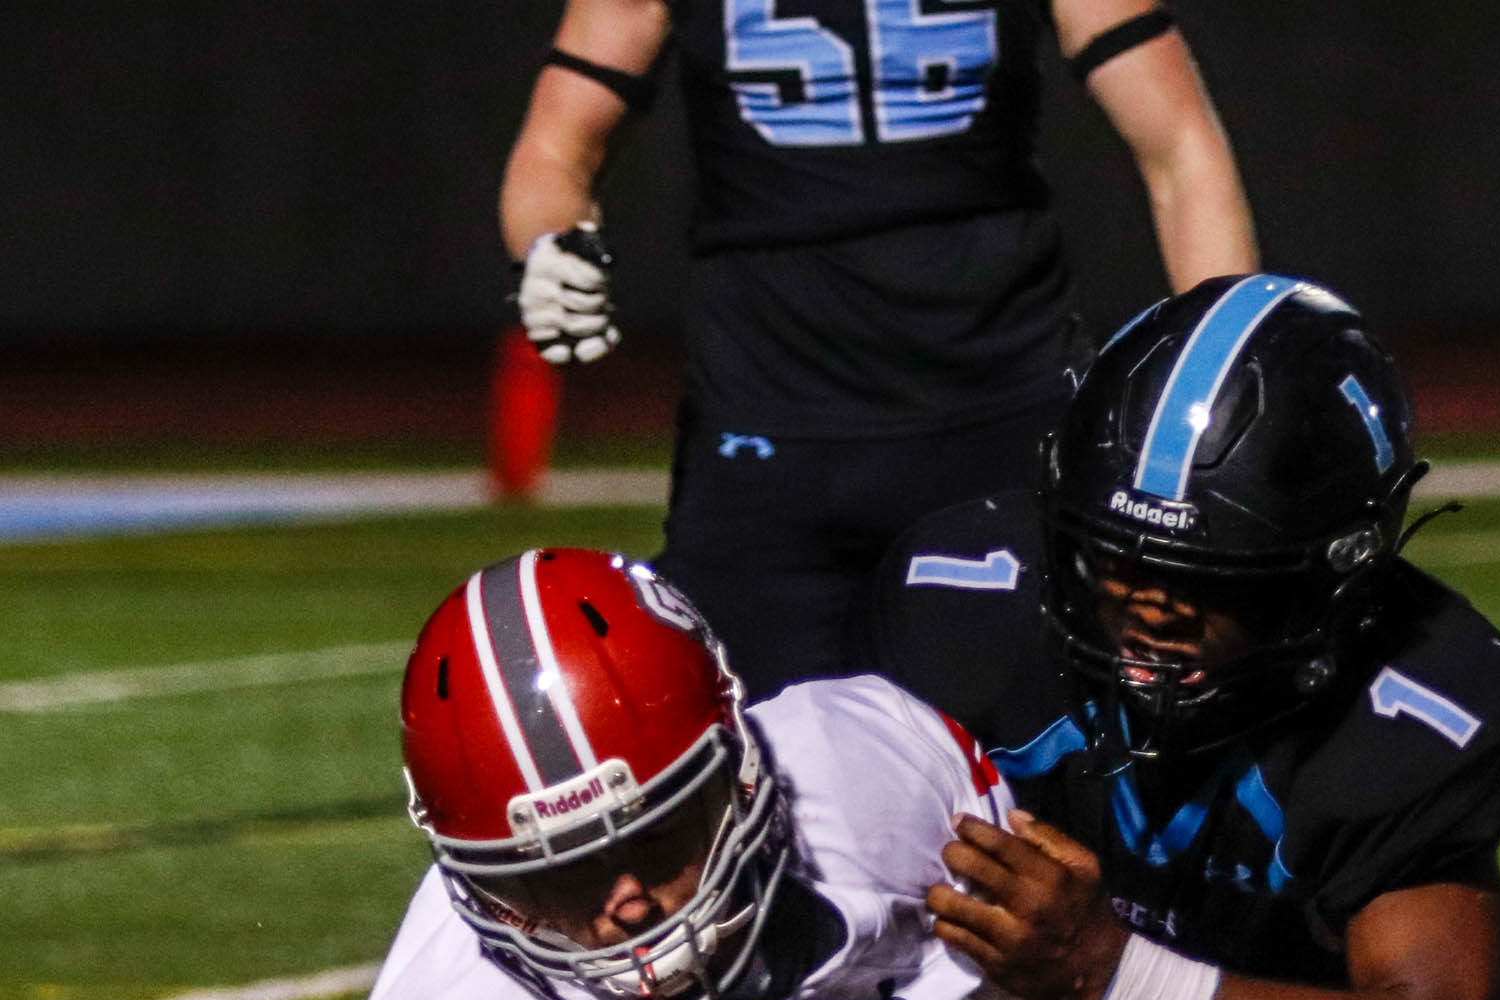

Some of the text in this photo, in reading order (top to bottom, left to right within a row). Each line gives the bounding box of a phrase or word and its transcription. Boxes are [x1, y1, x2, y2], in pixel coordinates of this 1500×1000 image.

[1338, 374, 1395, 475] 1
[906, 549, 1021, 591] 1
[1368, 666, 1484, 750] 1
[533, 776, 605, 820] Riddell
